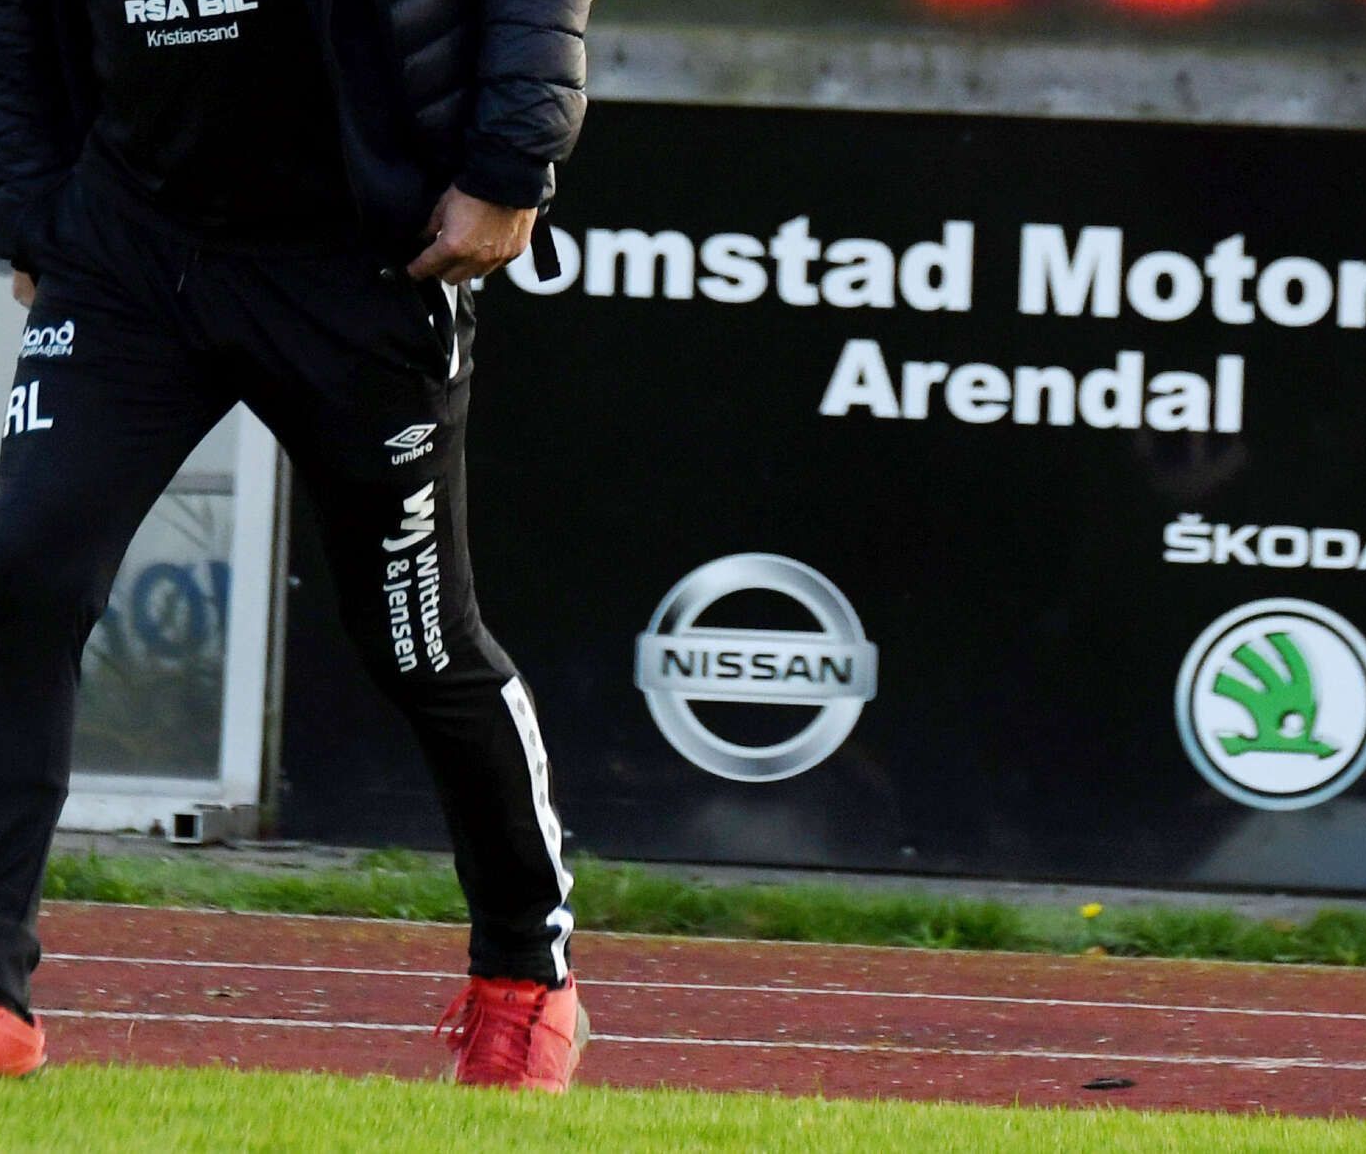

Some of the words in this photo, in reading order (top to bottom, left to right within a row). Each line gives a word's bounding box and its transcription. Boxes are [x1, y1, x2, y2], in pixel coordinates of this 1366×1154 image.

[146, 21, 239, 47] Kristiansand
[471, 216, 974, 312] omstad
[819, 338, 1245, 434] Arendal
[391, 442, 434, 465] umbro
[383, 579, 418, 673] Jensen
[416, 541, 450, 673] Wittusen
[661, 648, 853, 686] NISSAN
